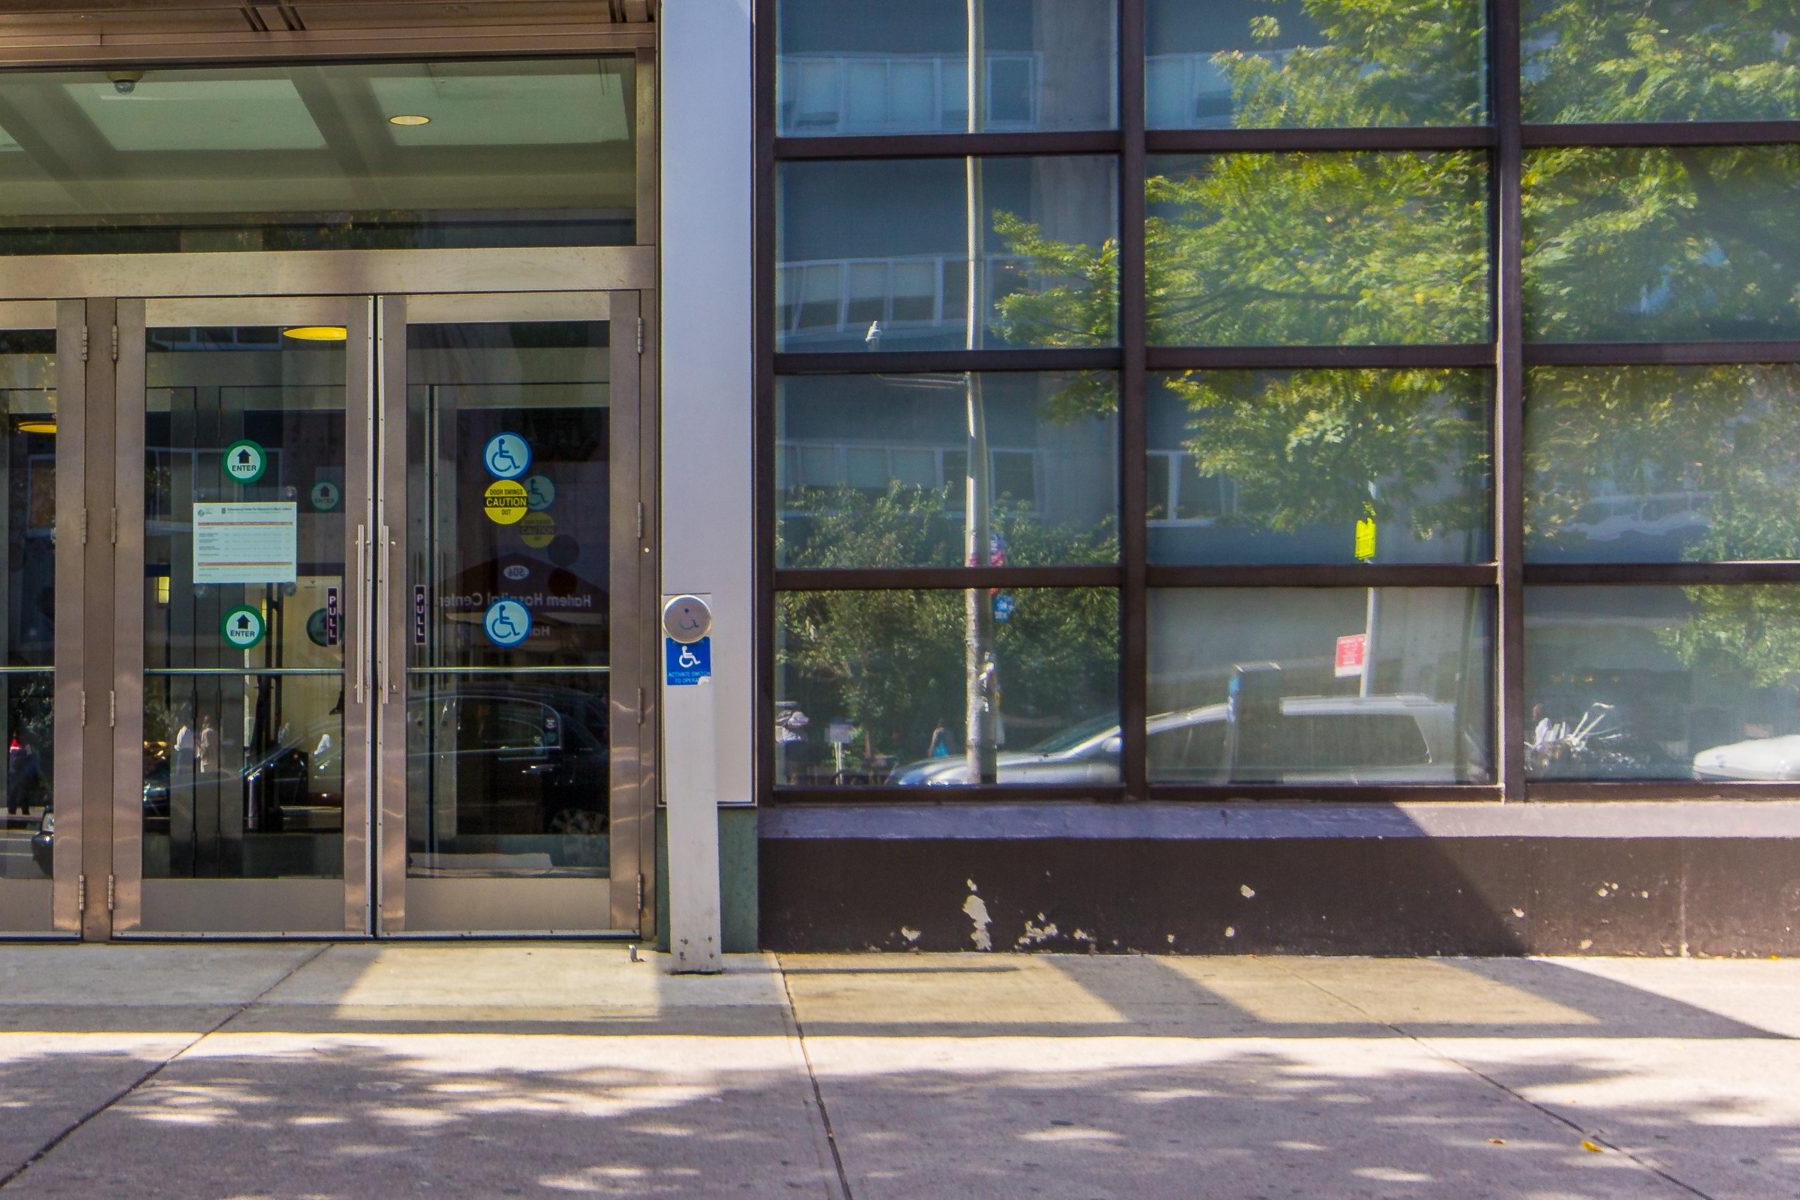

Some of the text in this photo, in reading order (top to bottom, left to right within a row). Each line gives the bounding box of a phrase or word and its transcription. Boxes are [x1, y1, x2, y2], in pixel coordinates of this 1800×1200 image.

[231, 464, 257, 472] ENTER
[486, 497, 527, 507] CAUTION
[329, 595, 337, 638] PULL
[416, 593, 424, 636] PULL
